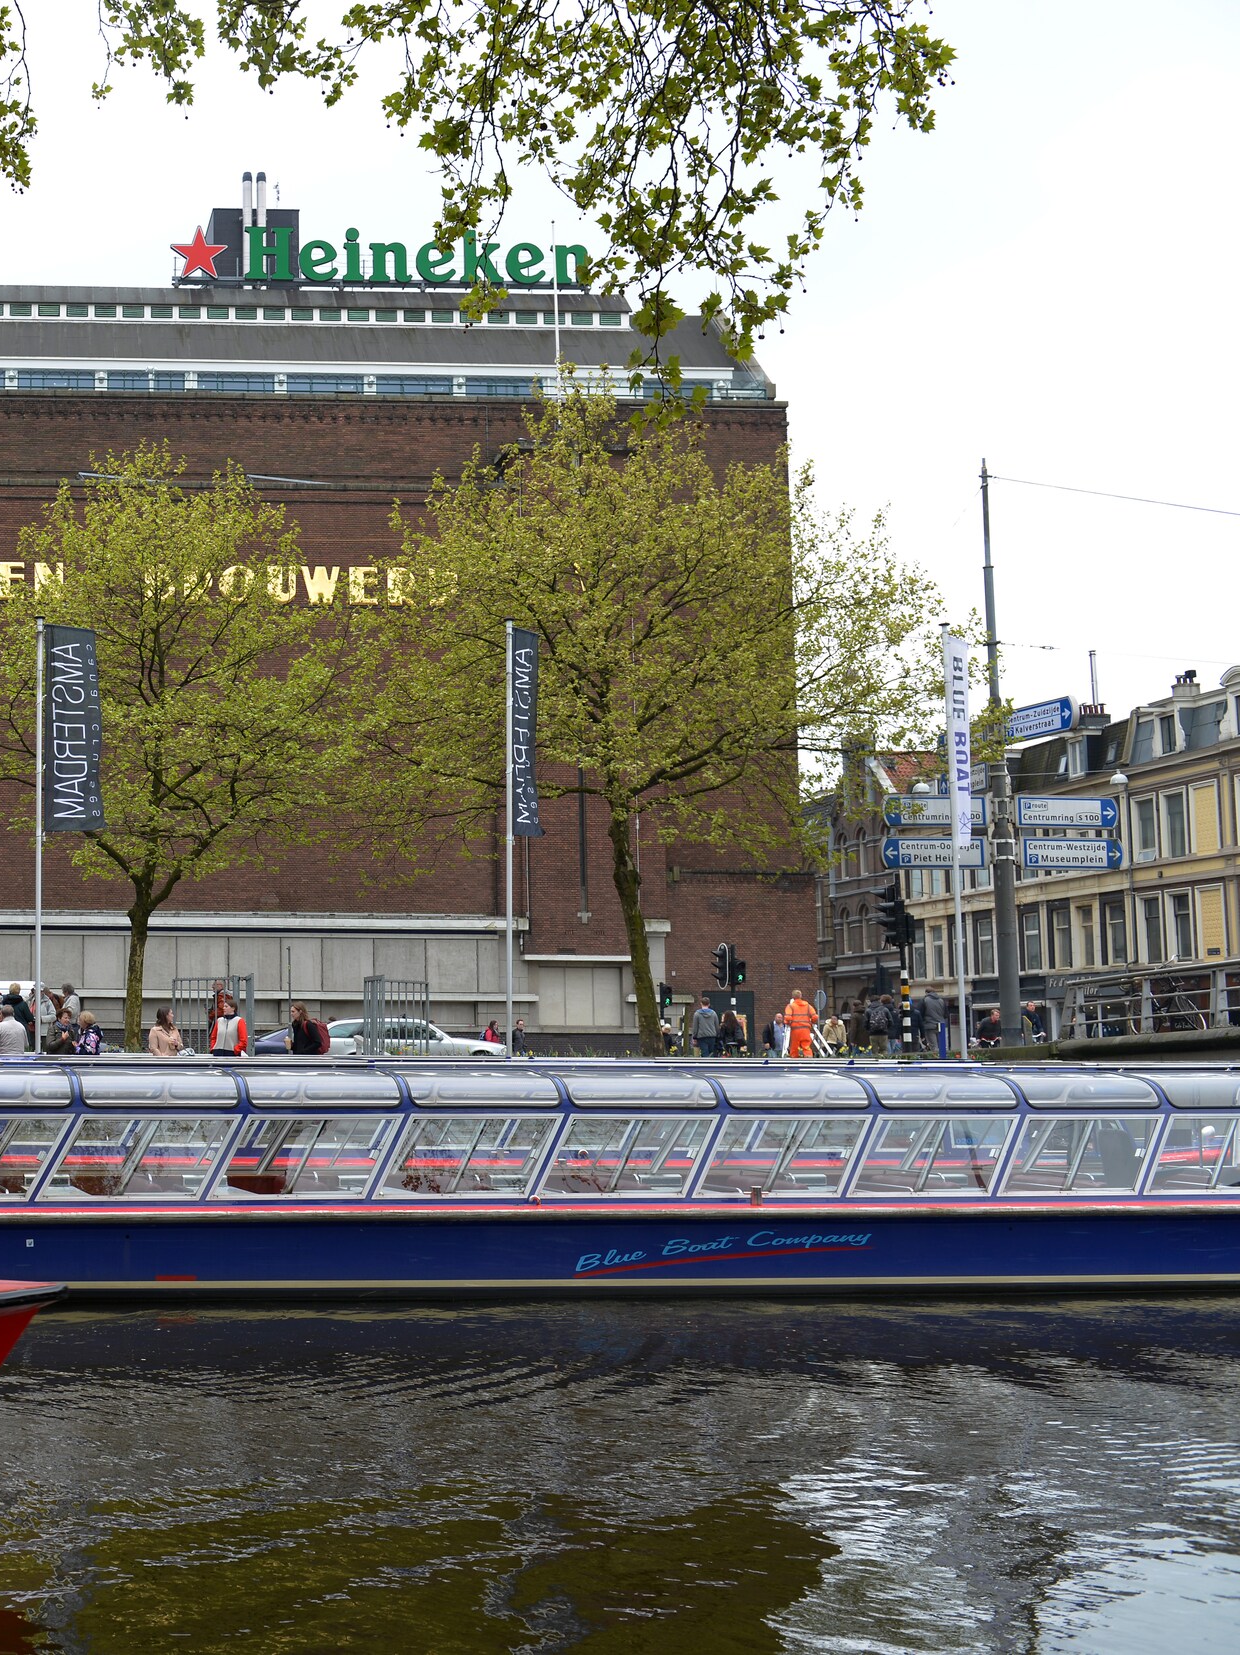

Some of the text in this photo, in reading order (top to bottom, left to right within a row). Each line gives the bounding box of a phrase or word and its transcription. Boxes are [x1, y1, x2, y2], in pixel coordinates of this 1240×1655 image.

[244, 226, 589, 284] Heineken
[1015, 718, 1055, 734] Kalverstraat
[902, 812, 952, 821] Centrumrin
[1023, 813, 1074, 823] Centrumring
[1085, 814, 1100, 822] 100
[900, 842, 980, 852] Centrum-Oozijde
[1028, 842, 1106, 852] Centrum-Westzijde
[913, 854, 932, 863] Piet
[1041, 855, 1104, 865] Museumplein
[575, 1231, 873, 1272] Blue Boat Company
